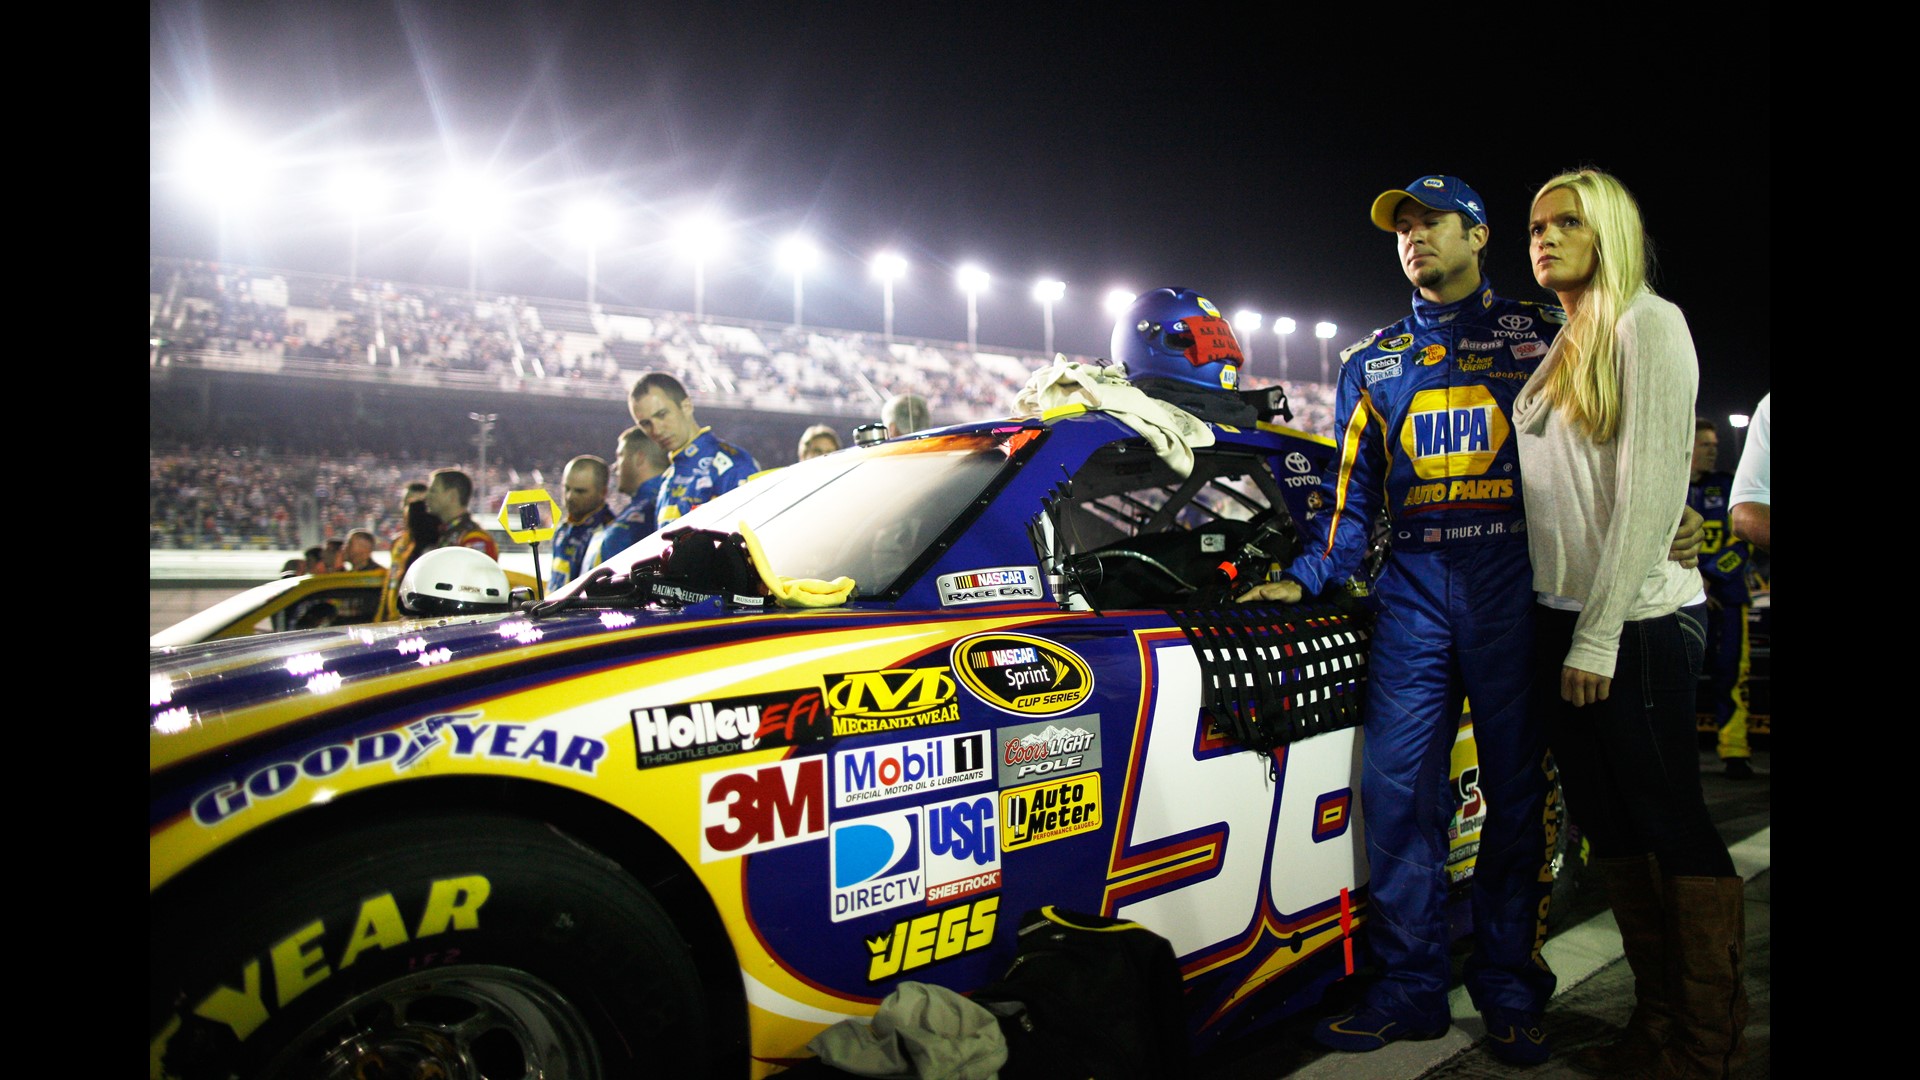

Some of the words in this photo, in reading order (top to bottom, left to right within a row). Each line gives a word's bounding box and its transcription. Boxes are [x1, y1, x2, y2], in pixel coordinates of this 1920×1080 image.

[1492, 330, 1538, 340] TOYOTA
[1370, 359, 1397, 369] Schick
[1489, 371, 1532, 380] GOODYE
[1414, 406, 1490, 457] NAPA
[1285, 475, 1322, 488] TOYOTA
[1404, 483, 1448, 506] AUTO
[1448, 479, 1515, 501] PARTS
[1445, 525, 1483, 540] TRUEX
[1487, 522, 1507, 535] JR.
[652, 584, 676, 598] RACING
[977, 570, 1024, 586] NASCAR
[947, 588, 997, 601] RACE
[999, 587, 1036, 597] CAR
[991, 647, 1039, 666] NASCAR
[1005, 664, 1051, 690] Sprint
[1017, 696, 1041, 708] CUP
[1042, 691, 1081, 704] SERIES
[634, 701, 760, 753] Holley
[754, 693, 820, 740] EFI
[831, 715, 917, 737] MECHANIX
[916, 703, 961, 724] WEAR
[641, 745, 705, 765] THROTTLE
[707, 742, 741, 755] BODY
[1004, 737, 1049, 766] Coors
[1049, 733, 1095, 757] LIGHT
[844, 740, 944, 793] Mobil
[1017, 755, 1083, 779] POLE
[845, 790, 882, 803] OFFICIAL
[884, 783, 913, 796] MOTOR
[915, 781, 928, 791] OIL
[929, 779, 936, 787] &
[937, 771, 984, 786] LUBRICANTS
[1031, 783, 1084, 813] Auto
[704, 766, 825, 853] 3M
[1029, 802, 1096, 834] Meter
[929, 797, 996, 866] USG
[1033, 825, 1073, 841] PERFORMANCE
[1073, 820, 1095, 832] GAUGES
[835, 874, 921, 916] DIRECTV
[927, 872, 997, 902] SHEETROCK
[868, 896, 1000, 982] JEGS
